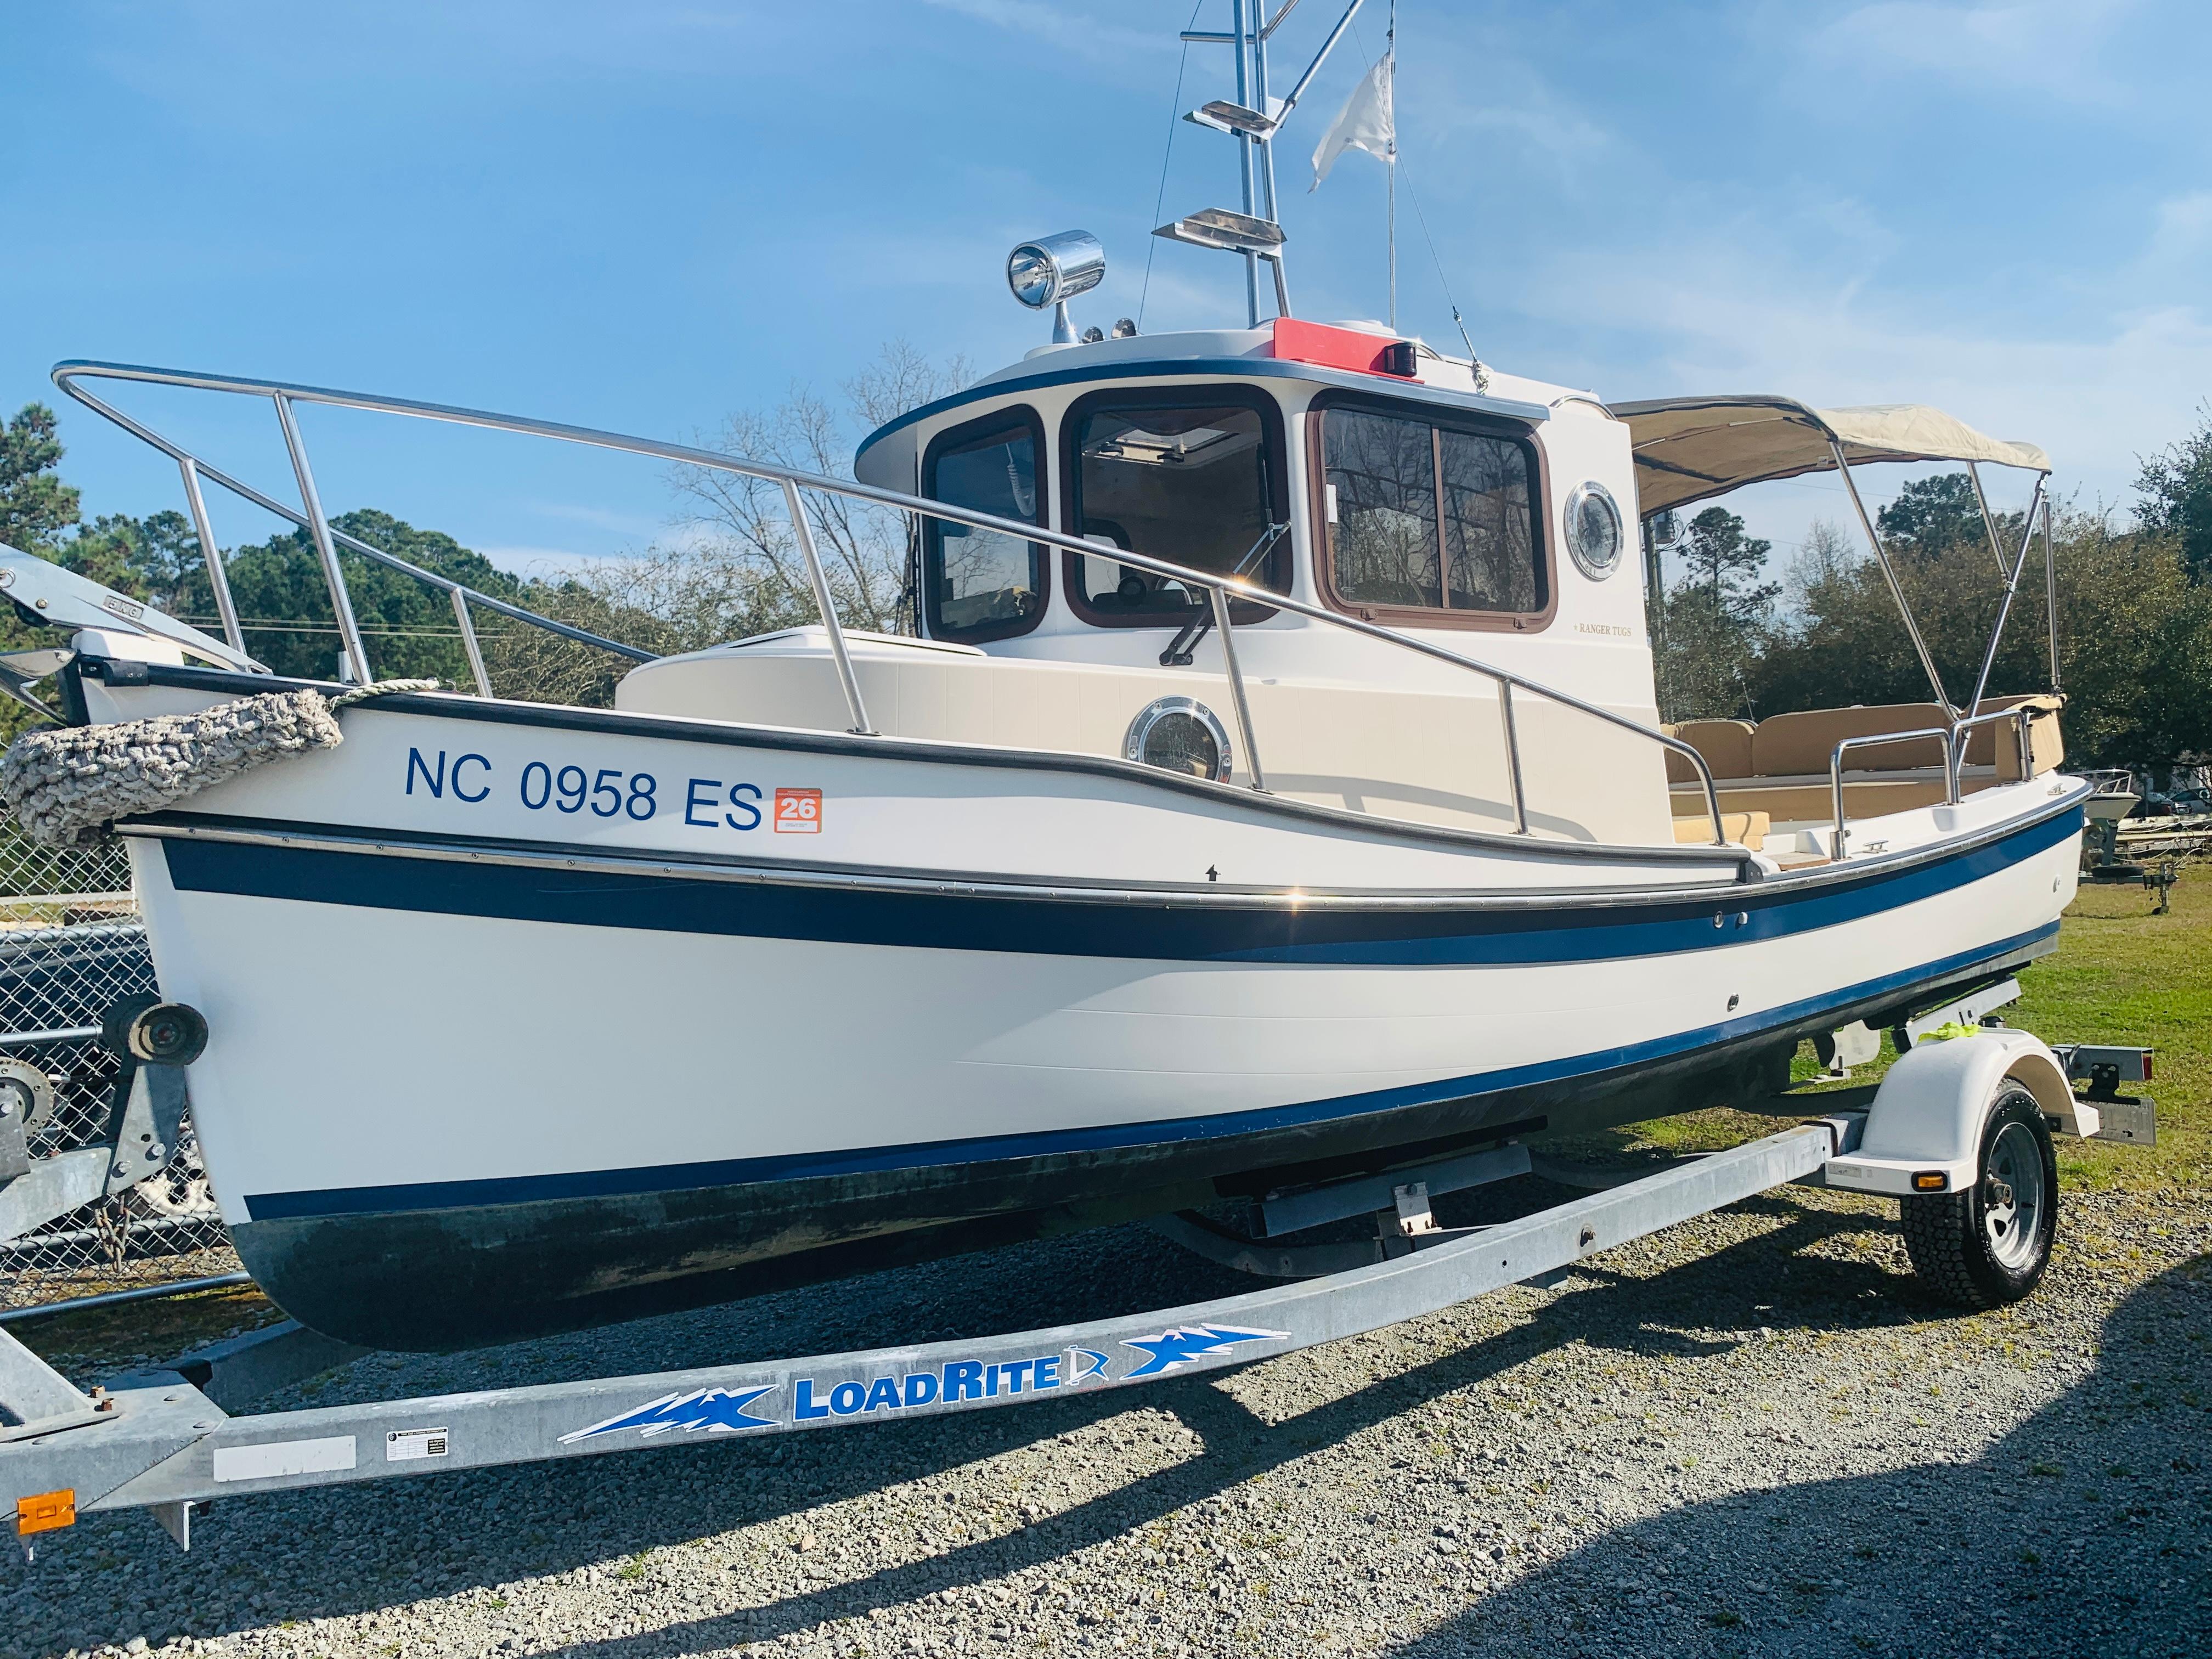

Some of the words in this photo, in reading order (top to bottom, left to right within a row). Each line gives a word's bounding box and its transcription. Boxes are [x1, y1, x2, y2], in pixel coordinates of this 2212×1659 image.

[1579, 623, 1611, 635] RANGER
[1612, 626, 1632, 636] TUGS
[407, 748, 492, 802] NC
[521, 761, 657, 821] 0958
[685, 779, 762, 831] ES
[780, 797, 816, 819] 26
[795, 1356, 1060, 1420] LOADRITE
